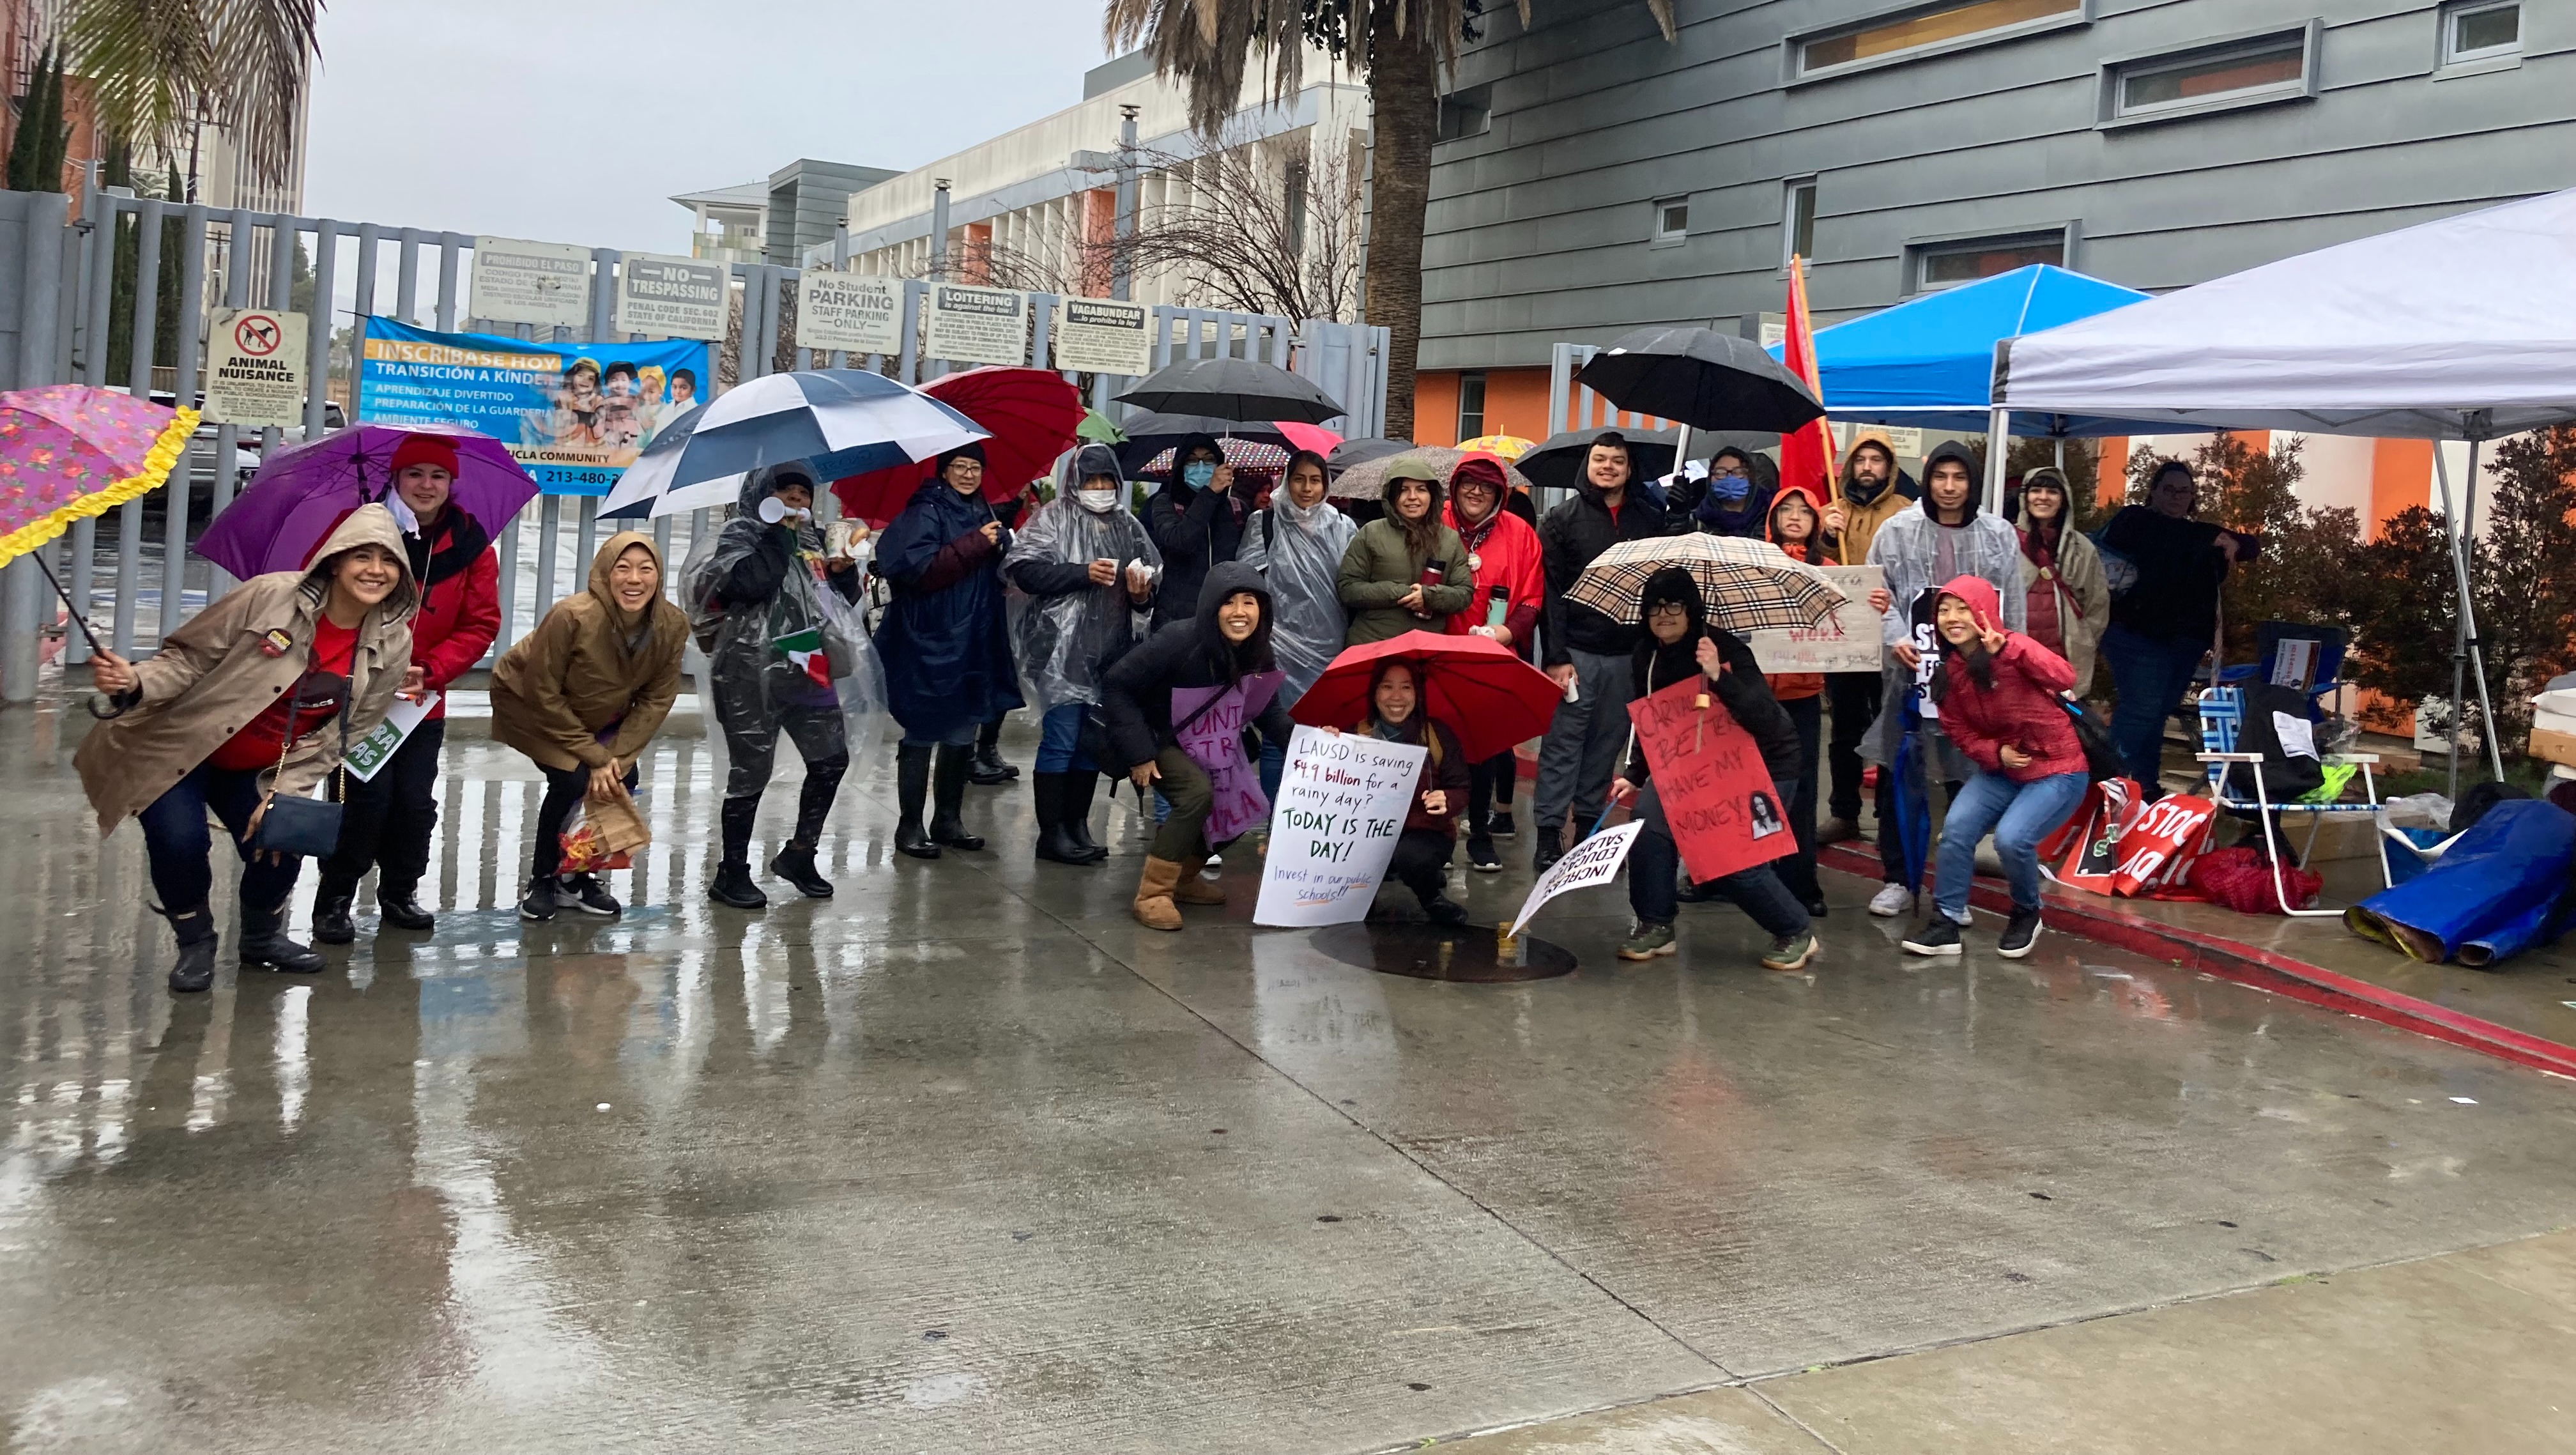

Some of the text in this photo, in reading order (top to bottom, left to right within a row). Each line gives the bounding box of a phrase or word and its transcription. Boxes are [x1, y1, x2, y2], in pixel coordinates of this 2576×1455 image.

[486, 254, 579, 272] PROHIBIDO EL PASO
[479, 276, 514, 284] ESTADO
[663, 267, 690, 282] NO
[632, 279, 718, 301] TRESPASSING
[818, 279, 886, 294] No Student
[809, 289, 894, 311] PARKING
[946, 291, 1013, 307] LOITERING
[953, 303, 981, 311] against
[627, 302, 656, 312] PENAL
[657, 305, 680, 314] CODE
[683, 307, 702, 316] SEC.
[812, 305, 889, 321] STAFF PARKING
[1071, 304, 1140, 320] VAGABUNDEAR
[627, 311, 652, 320] STATE
[668, 315, 717, 326] CALIFORNIA
[834, 318, 867, 330] ONLY
[1126, 319, 1137, 328] ley
[227, 357, 287, 370] ANIMAL
[376, 362, 475, 381] TRANSICIÓN
[479, 370, 489, 381] A
[510, 356, 556, 371] HOY
[218, 367, 295, 382] NUISANCE
[376, 385, 514, 402] APRENDIZAJE DIVERTIDO
[375, 398, 453, 412] PREPARACIÓN
[456, 404, 470, 414] DE
[473, 404, 486, 414] LA
[374, 413, 431, 424] AMBIENTE
[540, 452, 610, 463] COMMUNITY
[1300, 738, 1413, 777] LAUSD is saving
[1294, 759, 1319, 781] $4.9
[1326, 767, 1360, 786] billion
[1366, 773, 1384, 791] for
[1662, 746, 1744, 804] HAVE MY
[1292, 787, 1374, 815] rainy day?
[1675, 796, 1745, 839] MONEY
[1342, 819, 1358, 835] IS
[1365, 819, 1397, 838] THE
[1310, 840, 1354, 863] DAY!
[1275, 866, 1372, 886] Invest in our public
